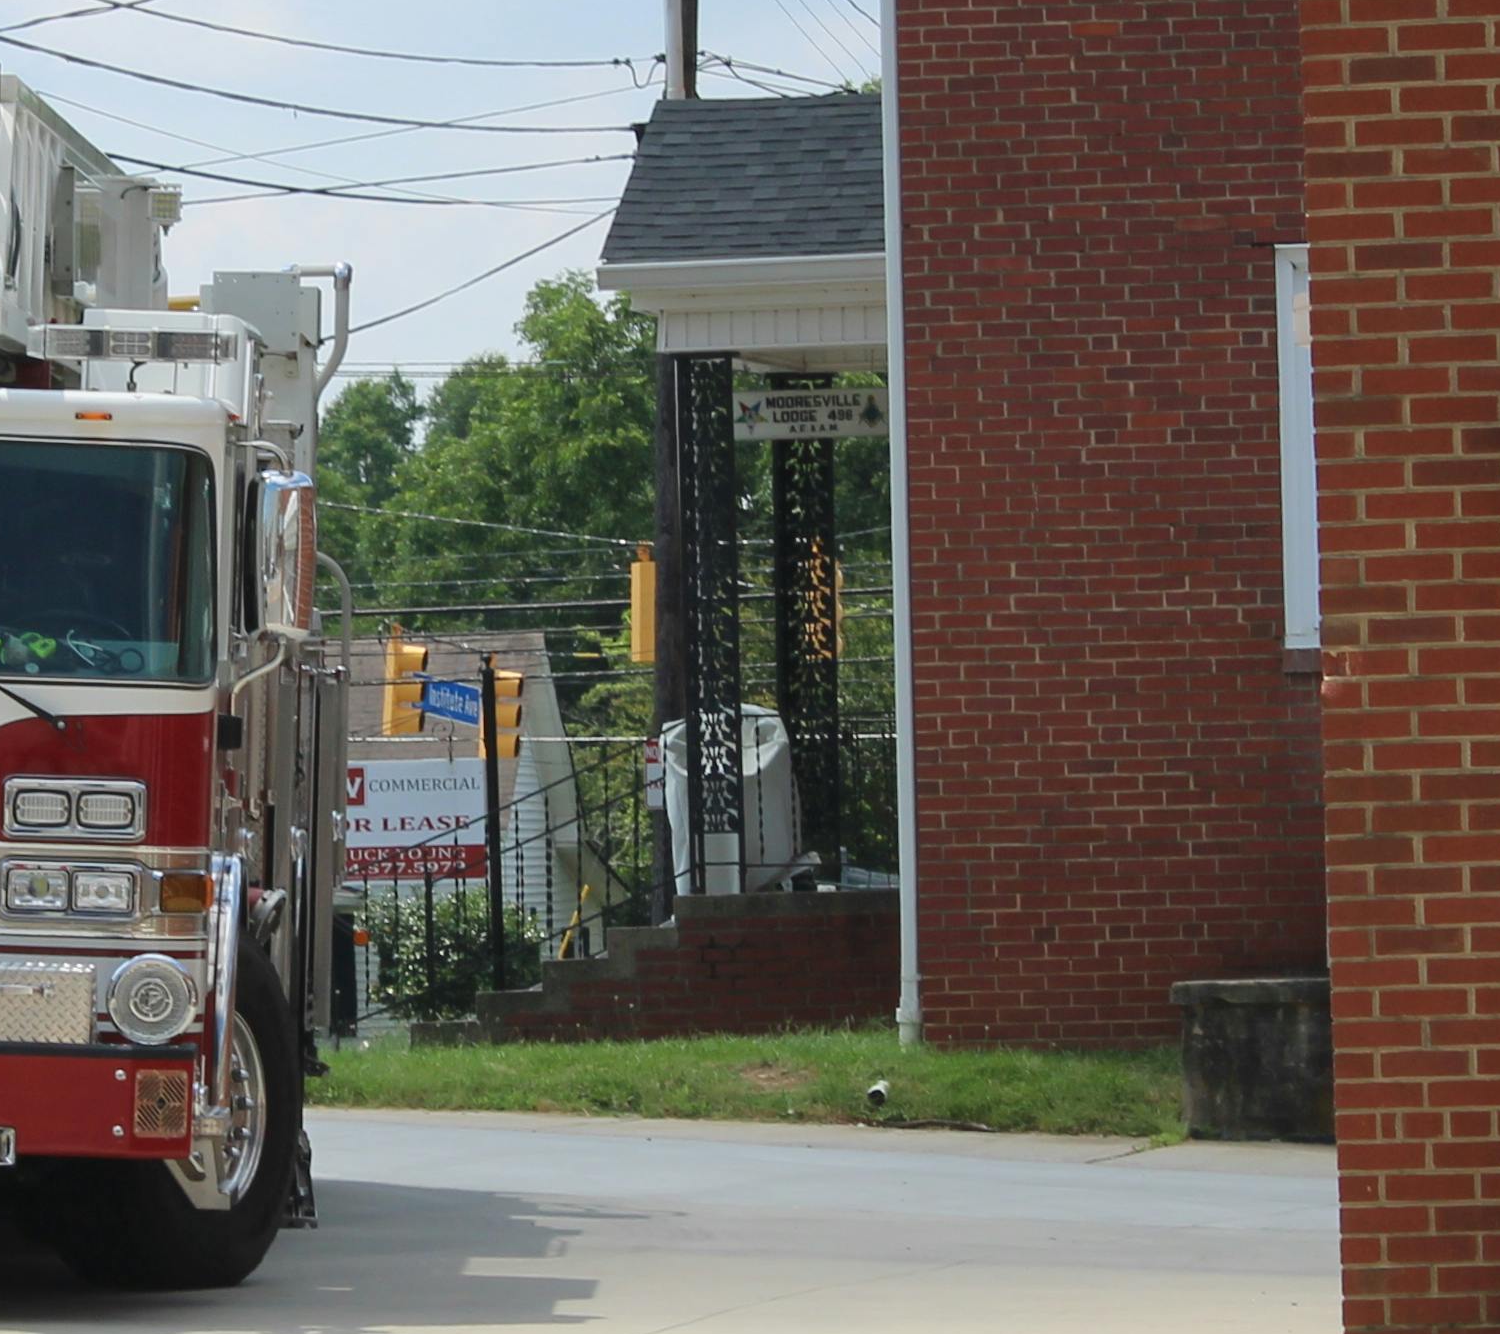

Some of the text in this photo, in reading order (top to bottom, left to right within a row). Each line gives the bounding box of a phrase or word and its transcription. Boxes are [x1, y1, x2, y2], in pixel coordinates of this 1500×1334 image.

[766, 394, 861, 409] MOORESVILLE
[773, 410, 817, 423] LODGE
[429, 683, 478, 717] Institute Ave
[369, 776, 480, 793] COMMERCIAL
[382, 815, 471, 832] LEASE
[350, 848, 389, 861] UCK
